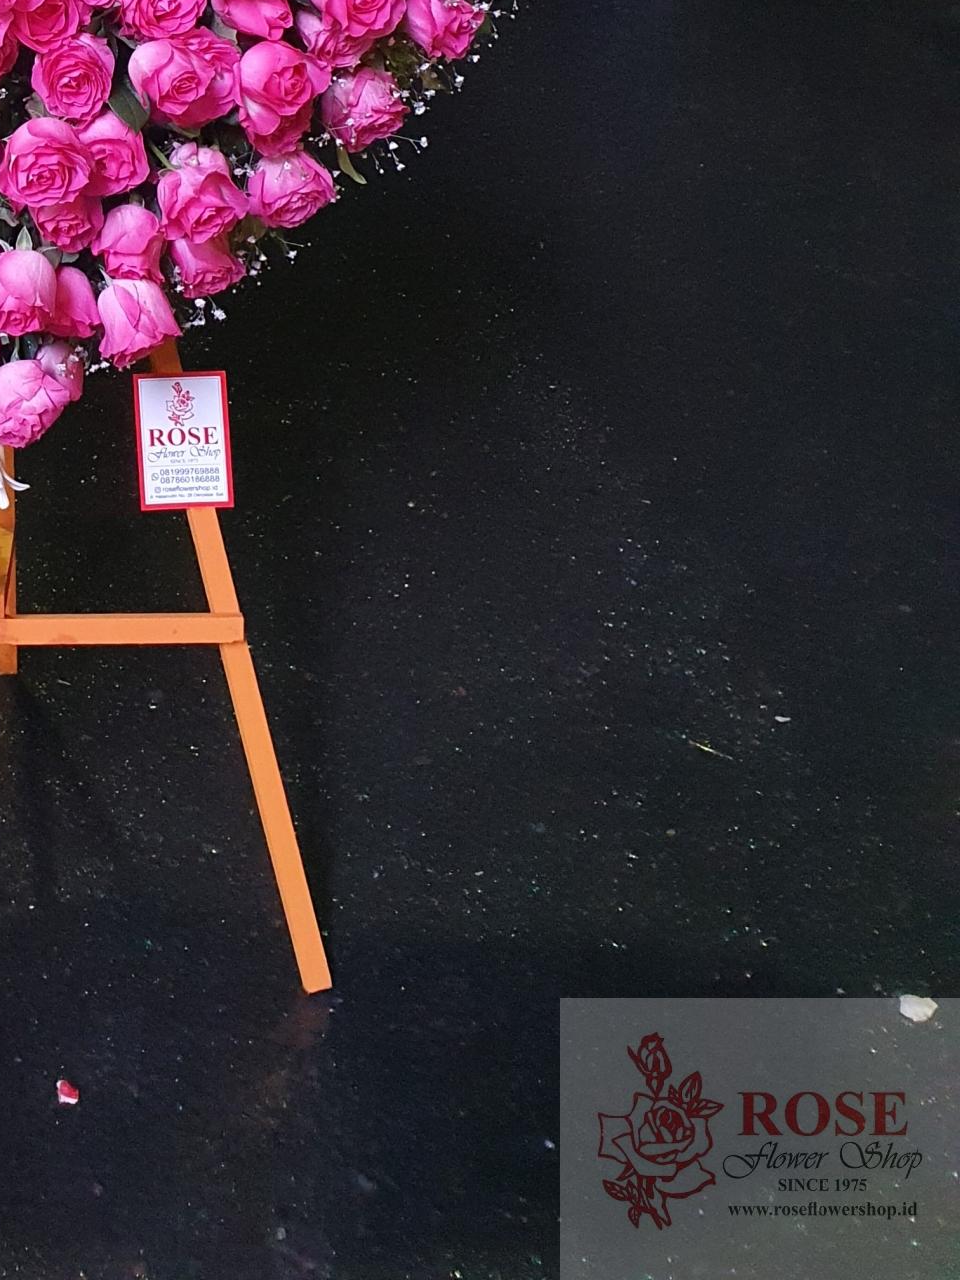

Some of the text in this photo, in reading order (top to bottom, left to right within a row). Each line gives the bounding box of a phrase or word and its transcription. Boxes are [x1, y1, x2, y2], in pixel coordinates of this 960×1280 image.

[148, 426, 219, 447] ROSE
[147, 445, 221, 463] Flower Shop
